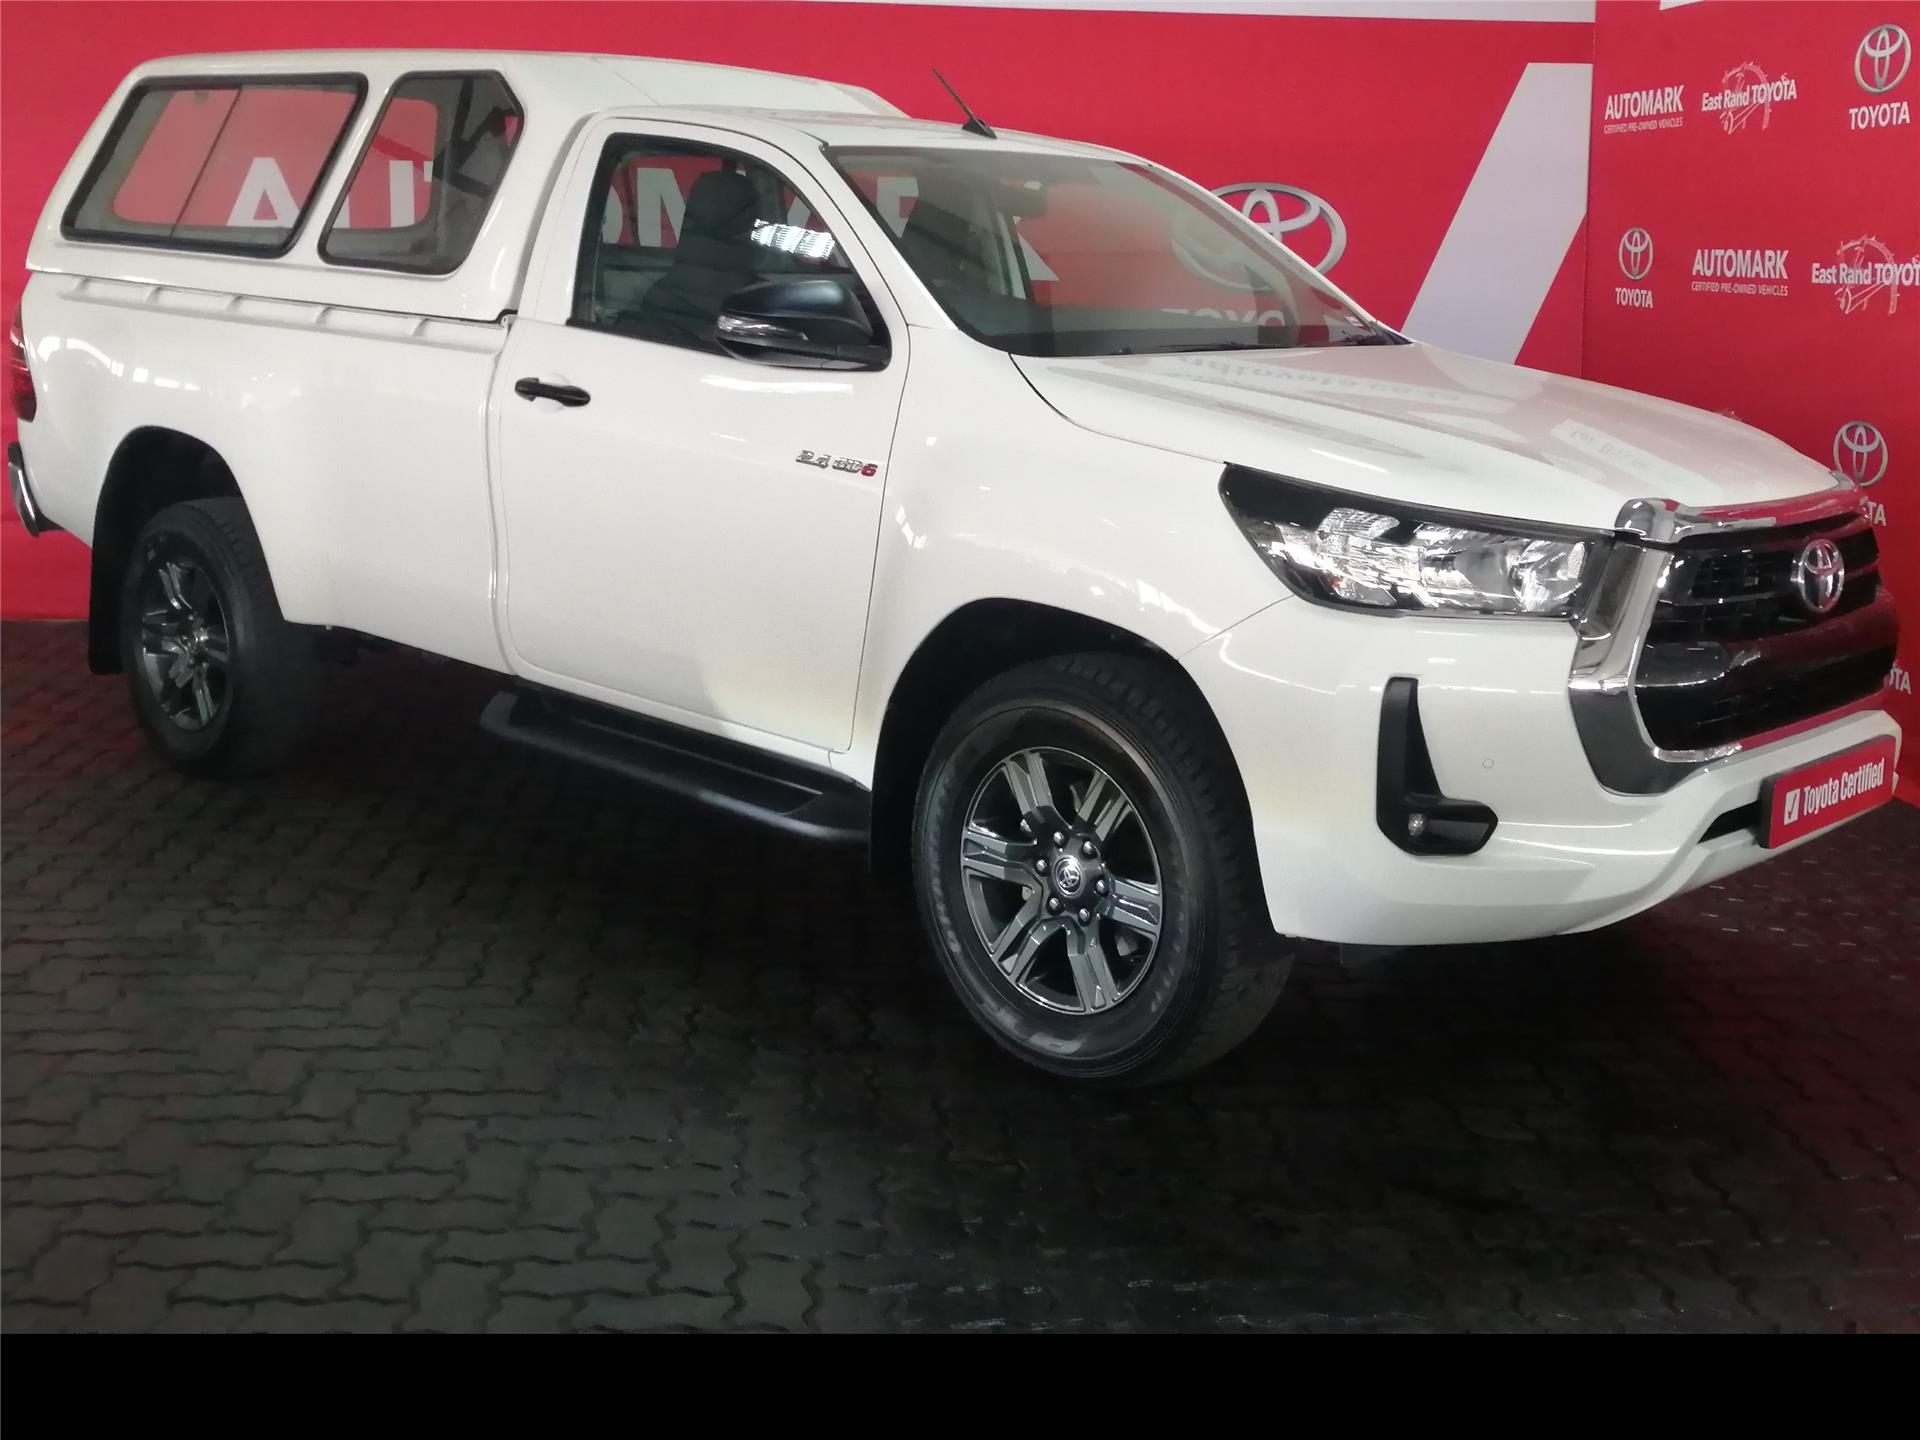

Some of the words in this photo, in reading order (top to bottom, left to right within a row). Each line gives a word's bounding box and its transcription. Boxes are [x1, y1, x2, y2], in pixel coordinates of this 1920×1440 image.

[1604, 85, 1685, 120] AUTOMARK
[1702, 91, 1723, 111] East
[1723, 85, 1750, 108] Rand
[1751, 80, 1797, 104] TOYOTA
[1848, 101, 1911, 130] TOYOTA
[1692, 248, 1789, 280] AUTOMARK
[1811, 262, 1837, 284] East
[1839, 261, 1872, 285] Rand
[1874, 262, 1920, 287] TOYOT
[1615, 287, 1653, 309] TOYOTA
[1803, 777, 1840, 816] Toyota
[1840, 757, 1885, 801] Certified
